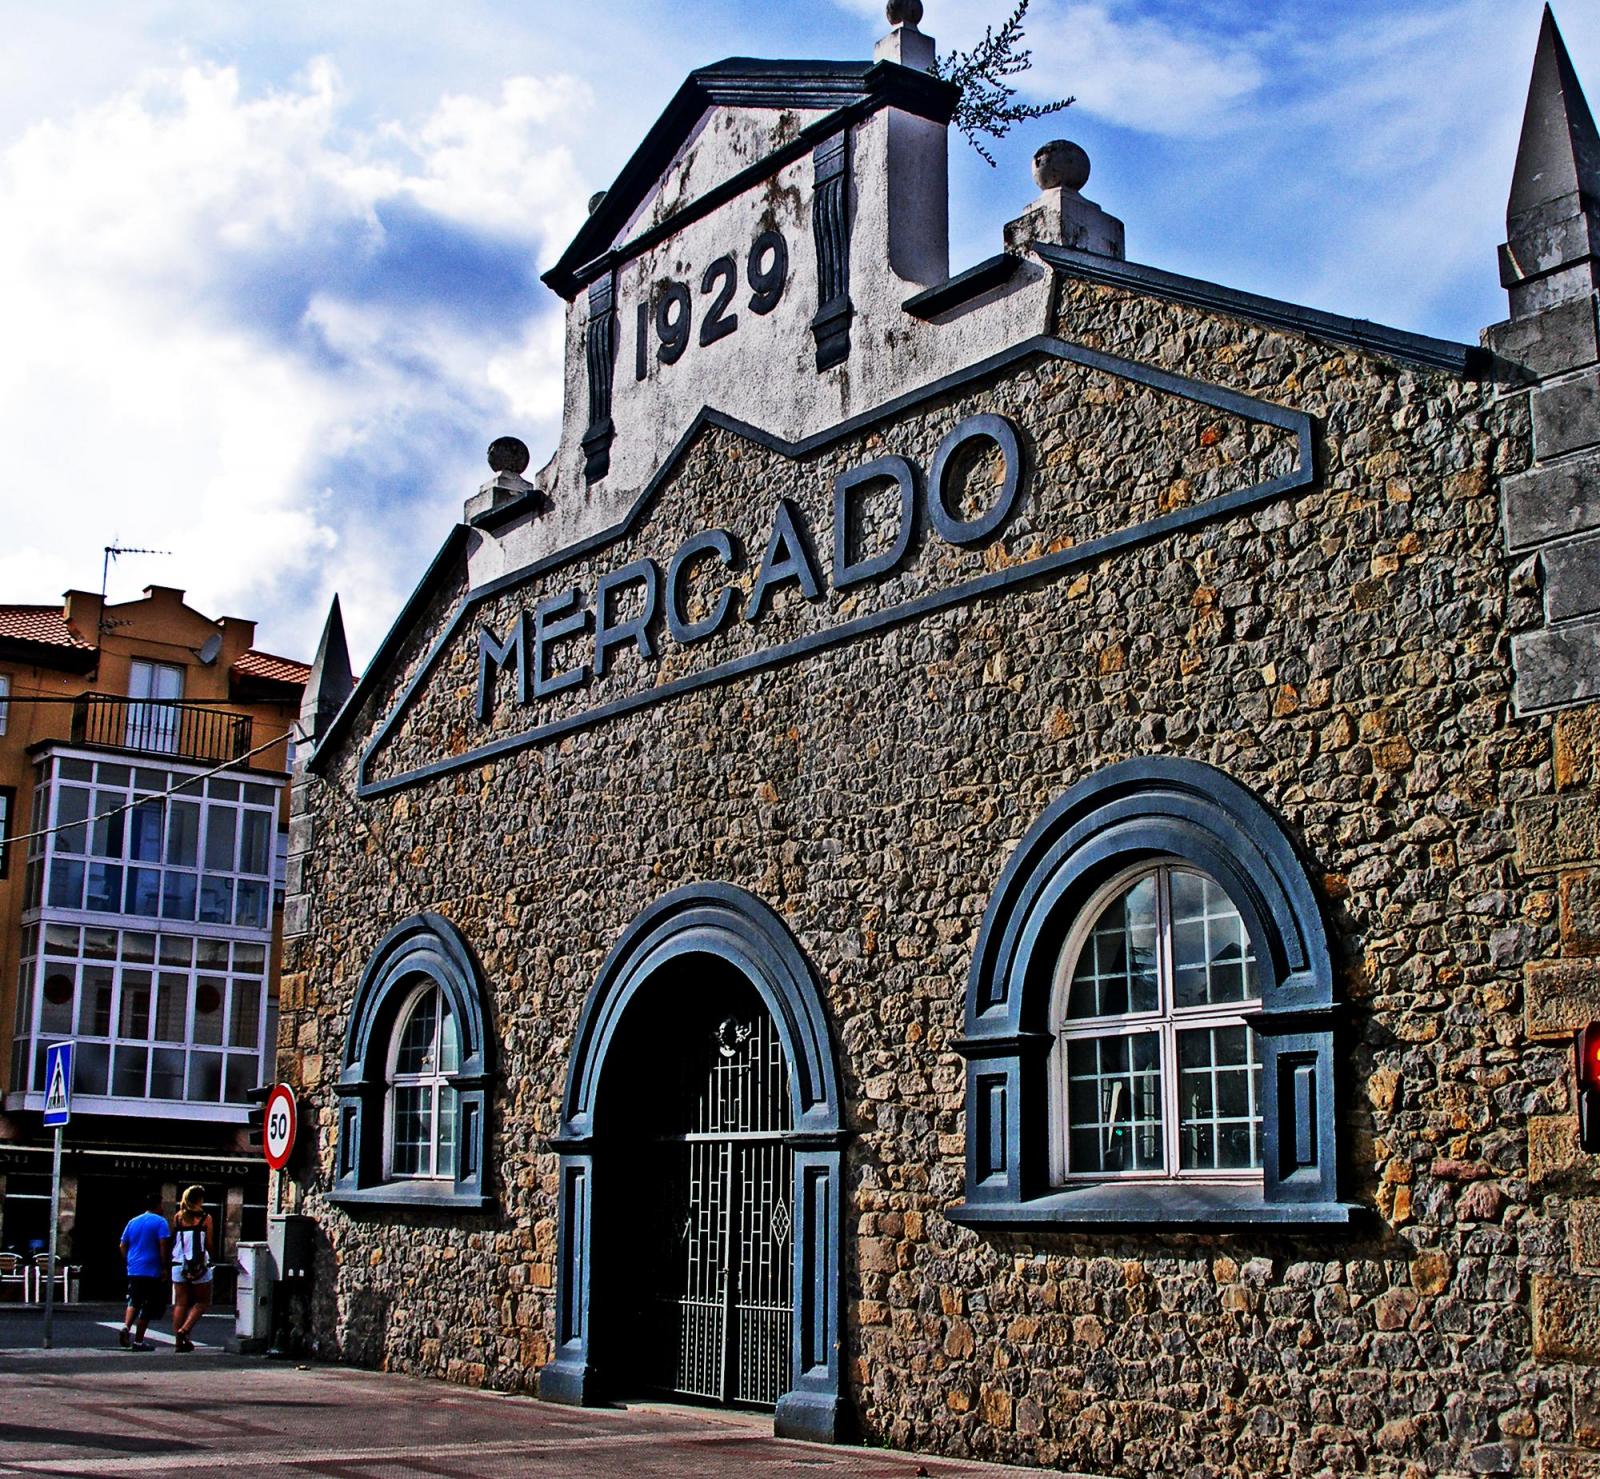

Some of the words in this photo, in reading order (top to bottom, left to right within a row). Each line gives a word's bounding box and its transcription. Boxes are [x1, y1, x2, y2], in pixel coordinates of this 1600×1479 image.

[636, 230, 788, 382] 1929
[475, 413, 1023, 721] MERCADO
[270, 1113, 287, 1140] 50
